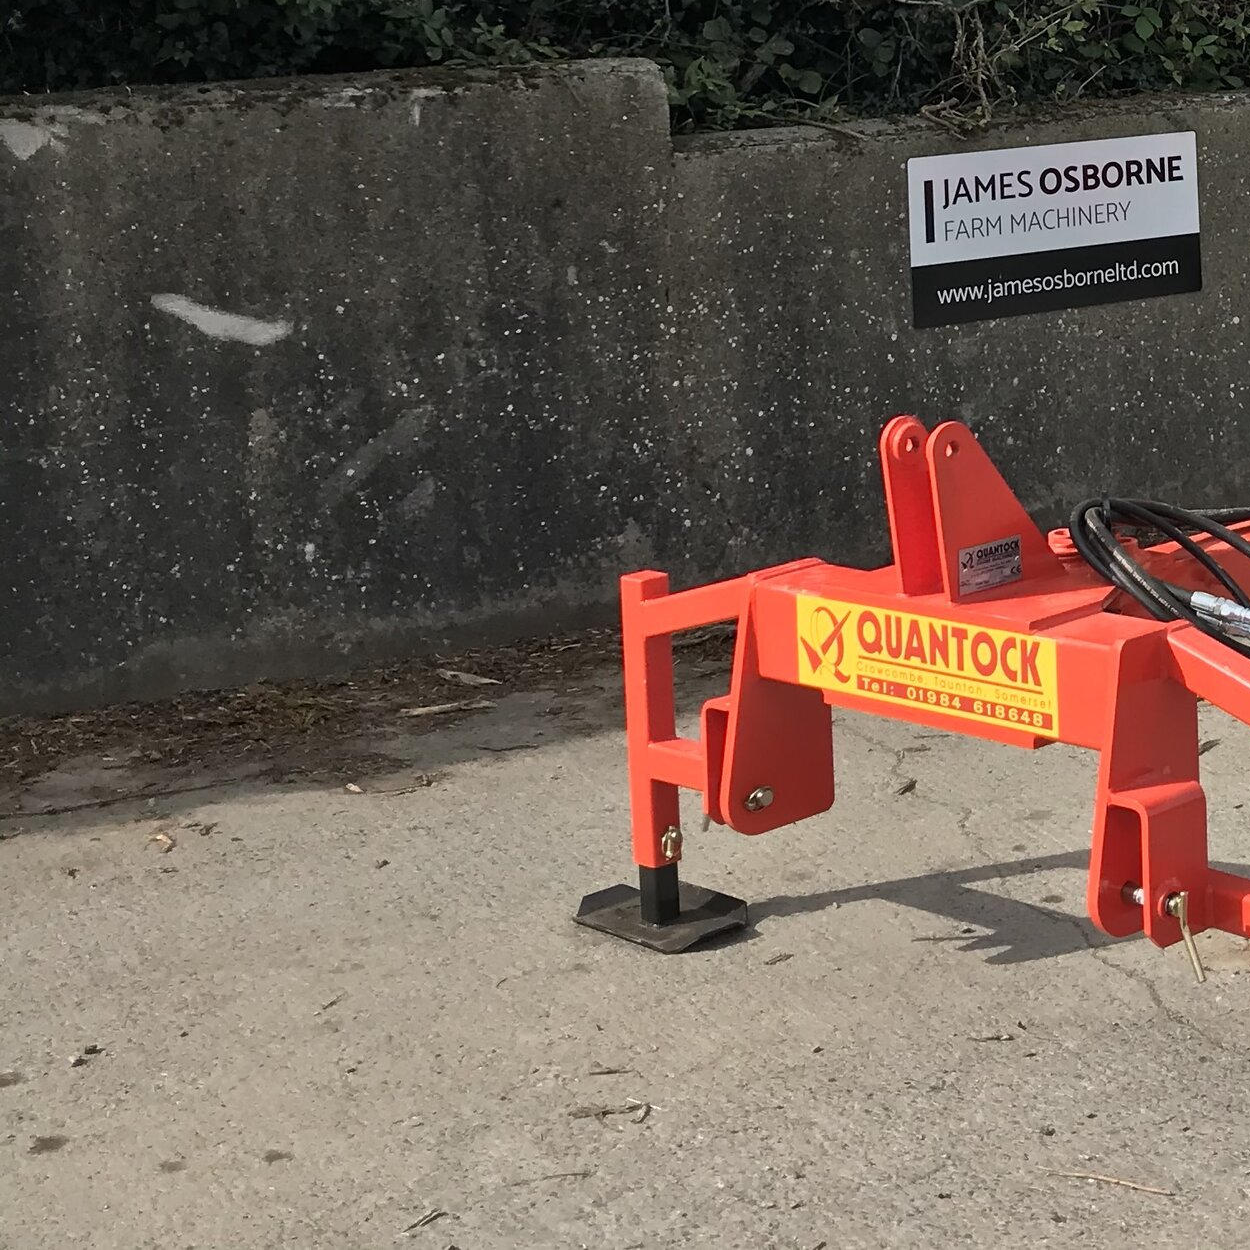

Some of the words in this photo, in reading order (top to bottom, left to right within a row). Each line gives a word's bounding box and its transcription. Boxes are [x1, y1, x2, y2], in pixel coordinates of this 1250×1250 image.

[942, 170, 1034, 210] JAMES
[1039, 155, 1184, 196] OSBORNE
[944, 215, 1003, 242] FARM
[1010, 200, 1131, 234] MACHINERY
[936, 257, 1180, 305] www.jamesosborneltd.com
[976, 539, 1020, 559] QUANTOCK
[857, 610, 1042, 687] QUANTOCK
[862, 677, 894, 696] Tel:
[906, 686, 962, 709] 01984
[973, 701, 1044, 727] 618648
[994, 688, 1052, 710] Somerset
